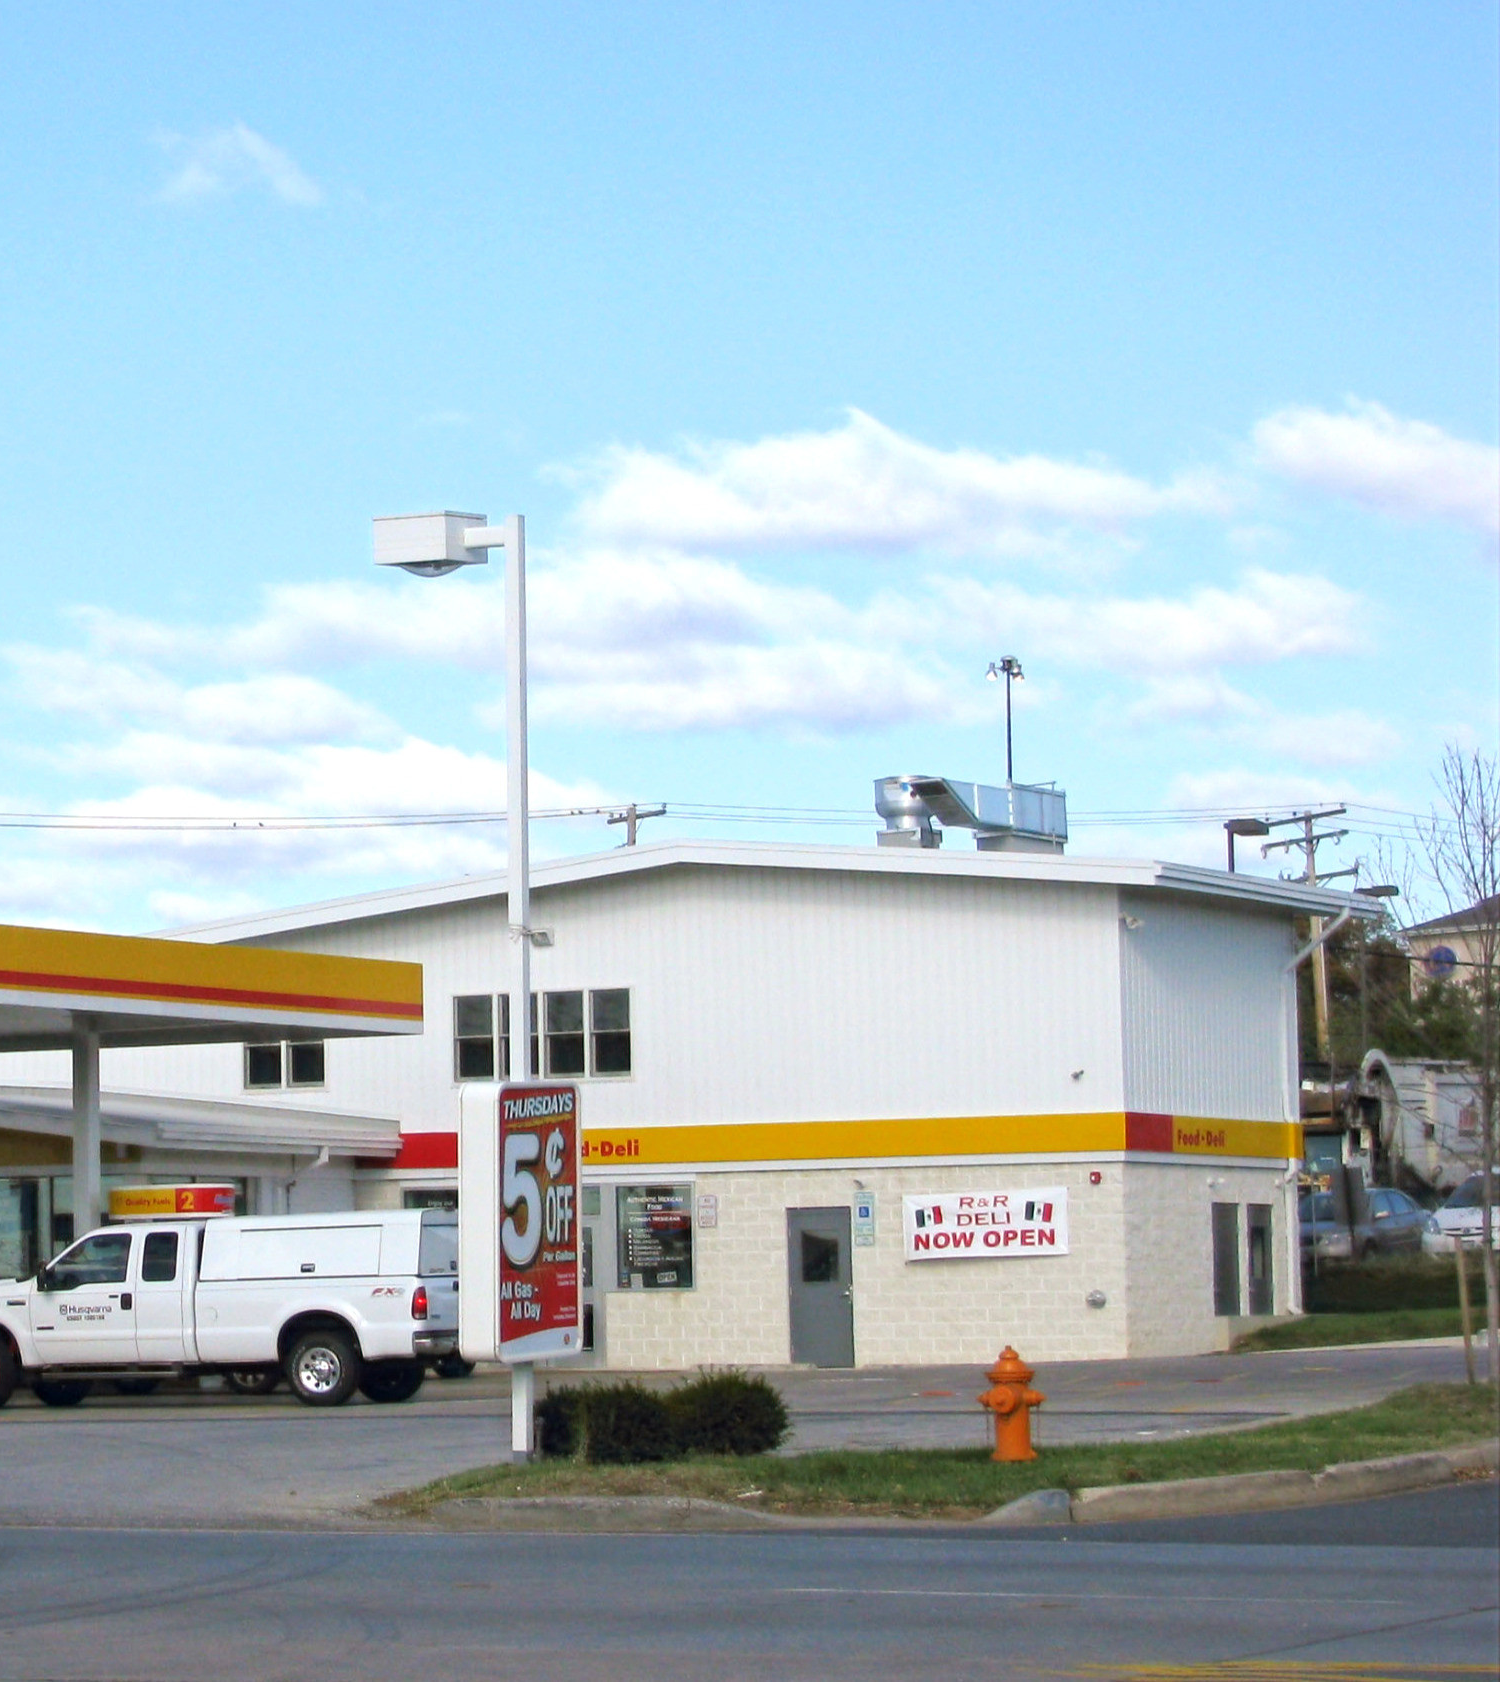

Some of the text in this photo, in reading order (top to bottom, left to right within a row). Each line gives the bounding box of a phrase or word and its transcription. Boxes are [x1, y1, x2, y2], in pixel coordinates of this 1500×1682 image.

[504, 1093, 574, 1119] THURSDAYS
[125, 1198, 150, 1207] Quality
[181, 1191, 195, 1210] 2
[546, 1185, 573, 1243] OFF
[956, 1211, 1011, 1226] DELI
[914, 1228, 1056, 1251] NOW OPEN
[543, 1251, 555, 1262] Per
[501, 1281, 513, 1299] All
[514, 1280, 533, 1299] Gas
[68, 1304, 112, 1314] Husqvarna
[510, 1301, 522, 1320] All
[524, 1301, 541, 1322] Day
